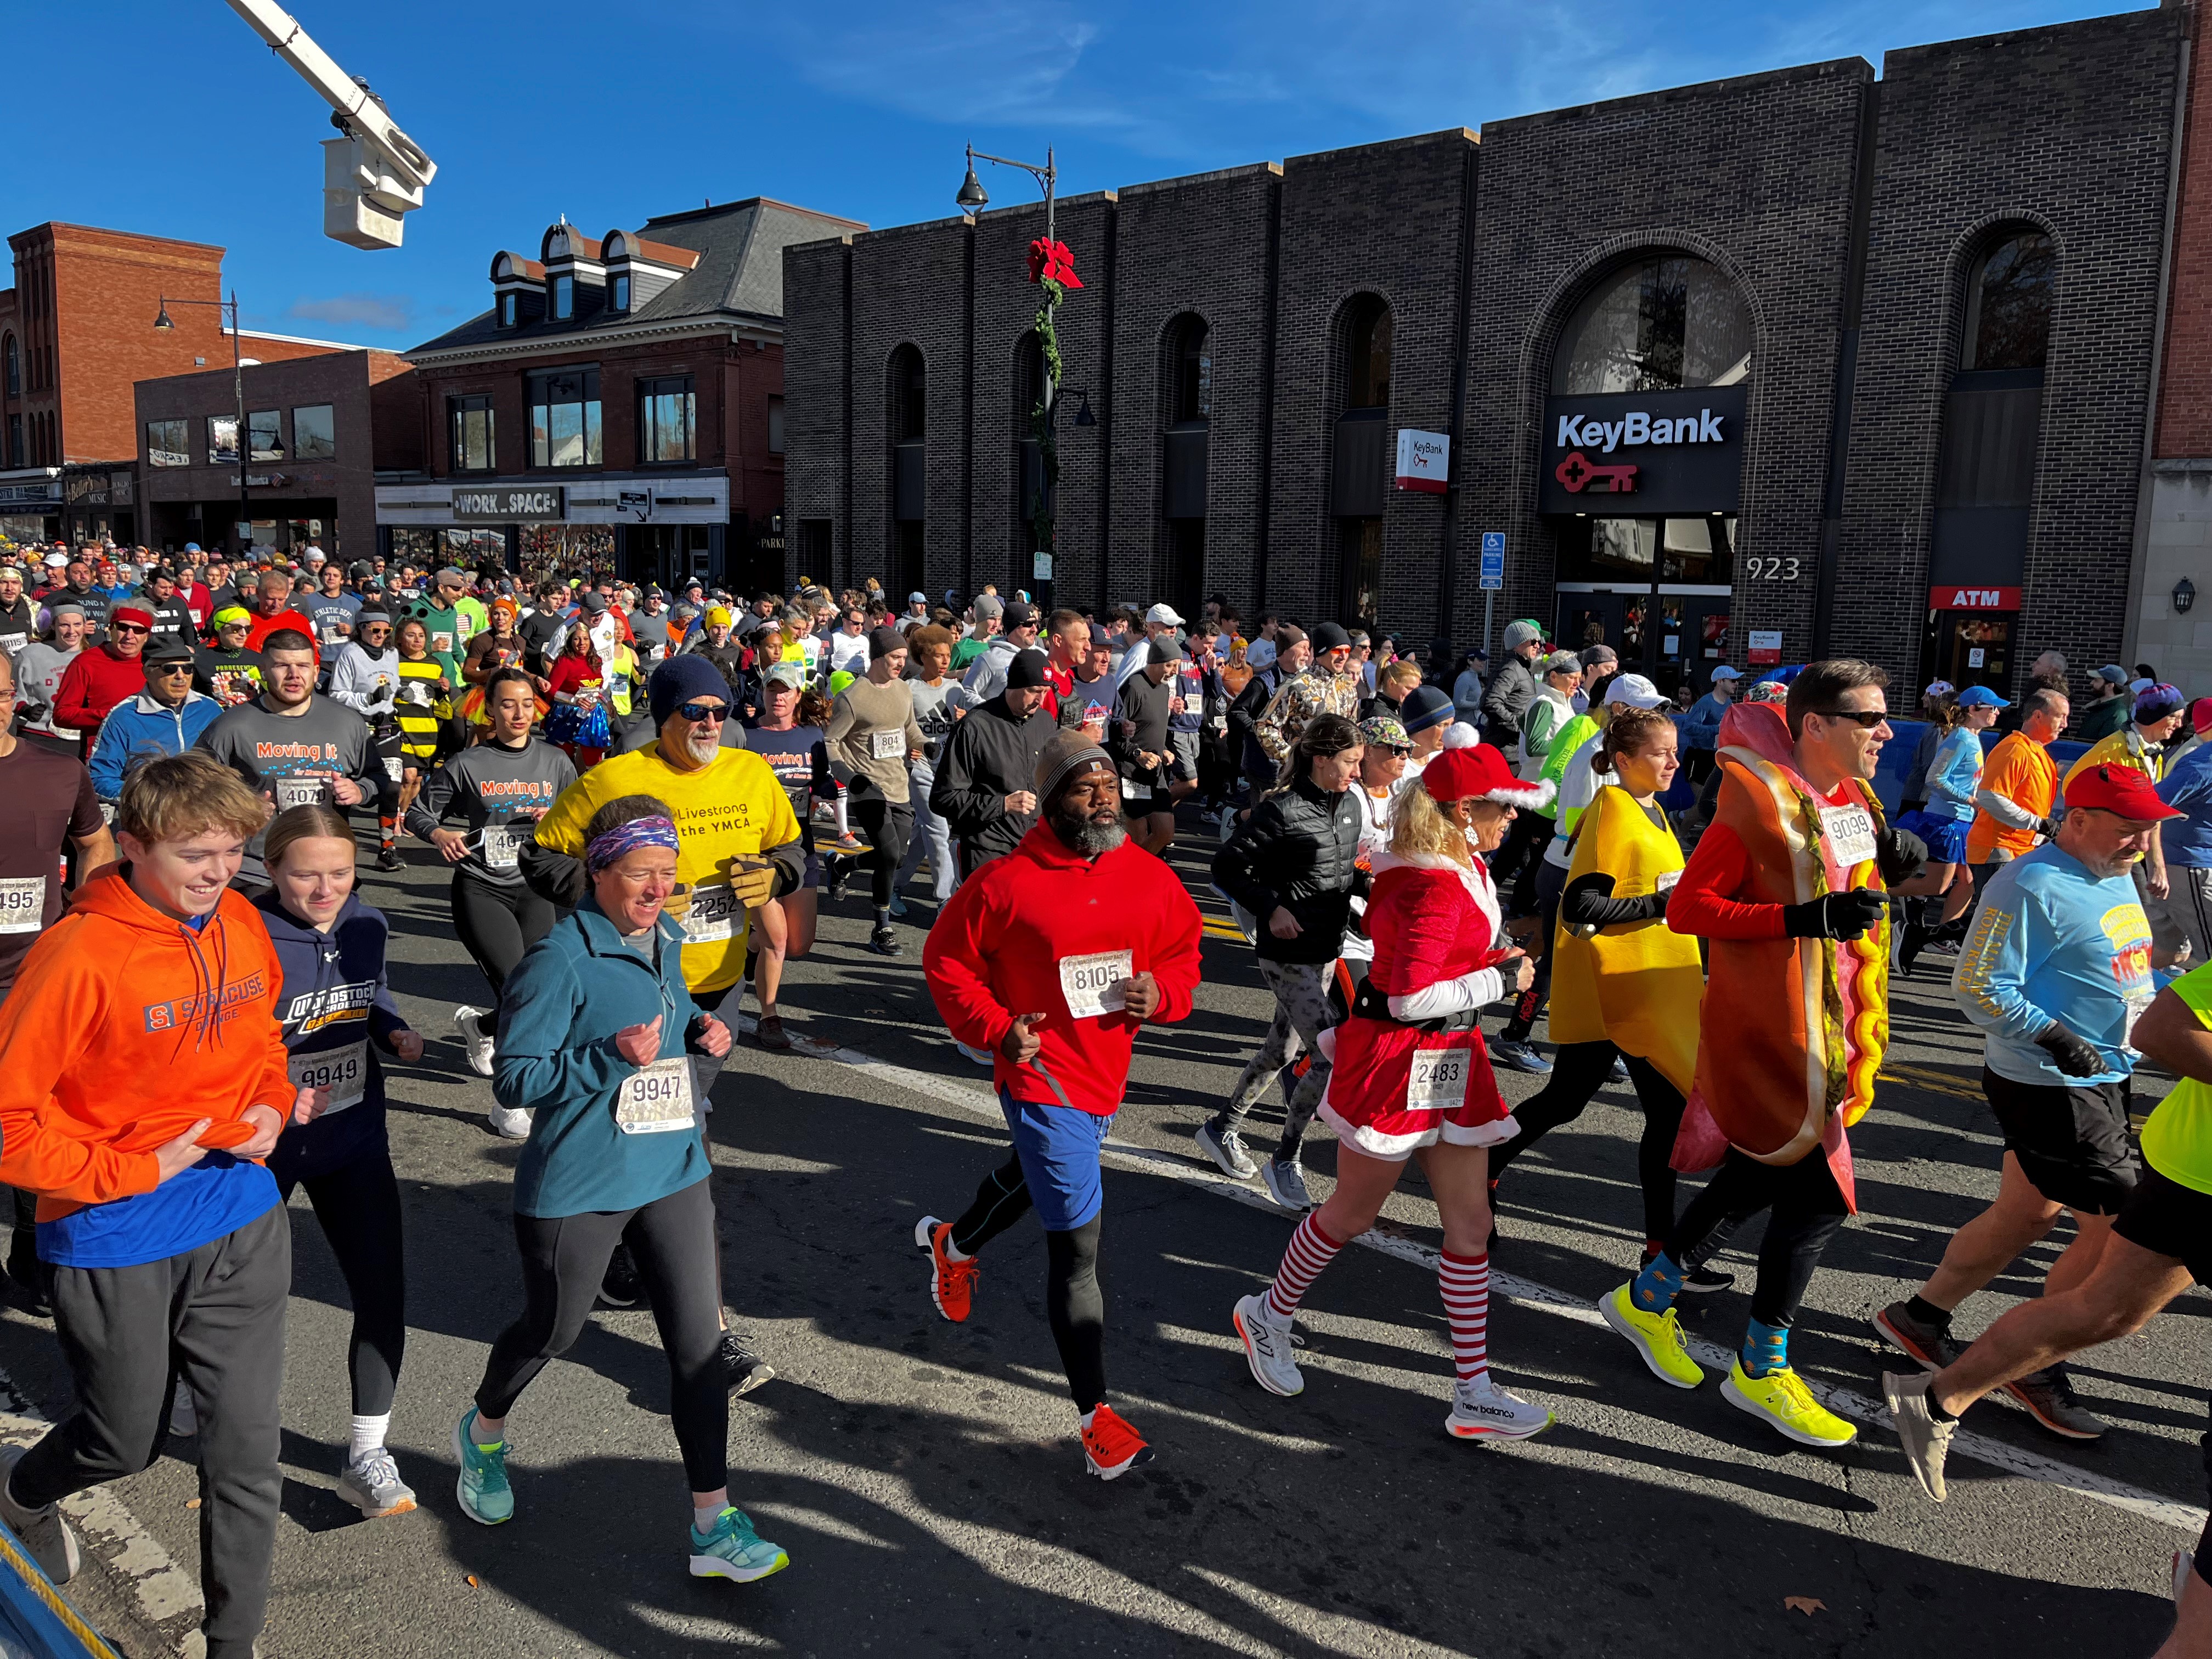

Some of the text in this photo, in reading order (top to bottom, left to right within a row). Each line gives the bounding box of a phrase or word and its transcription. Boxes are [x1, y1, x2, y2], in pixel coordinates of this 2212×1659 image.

[1557, 408, 1725, 453] KeyBank
[1413, 440, 1443, 455] KeyBank
[71, 475, 93, 501] Beller's
[88, 493, 106, 504] MUSIC
[761, 538, 784, 548] PARKI
[1747, 557, 1800, 581] 923
[1951, 590, 2000, 607] ATM
[882, 735, 899, 746] 804
[256, 741, 338, 763] Moving it
[286, 788, 326, 804] 4070
[480, 778, 553, 799] Moving it
[677, 803, 748, 821] Livestrong
[681, 817, 751, 837] the YMCA
[1831, 814, 1870, 840] 9099
[496, 833, 534, 848] 407
[691, 893, 738, 919] 2252
[1959, 906, 1999, 986] ROAD RACE
[1075, 964, 1119, 990] 8105
[181, 975, 265, 1019] SYRACUSE
[294, 984, 375, 1017] WDSTOCK
[196, 1009, 240, 1032] ONGE
[301, 1058, 357, 1088] 9949
[1417, 1063, 1459, 1084] 2483
[633, 1075, 680, 1102] 9947
[1462, 1402, 1479, 1412] new
